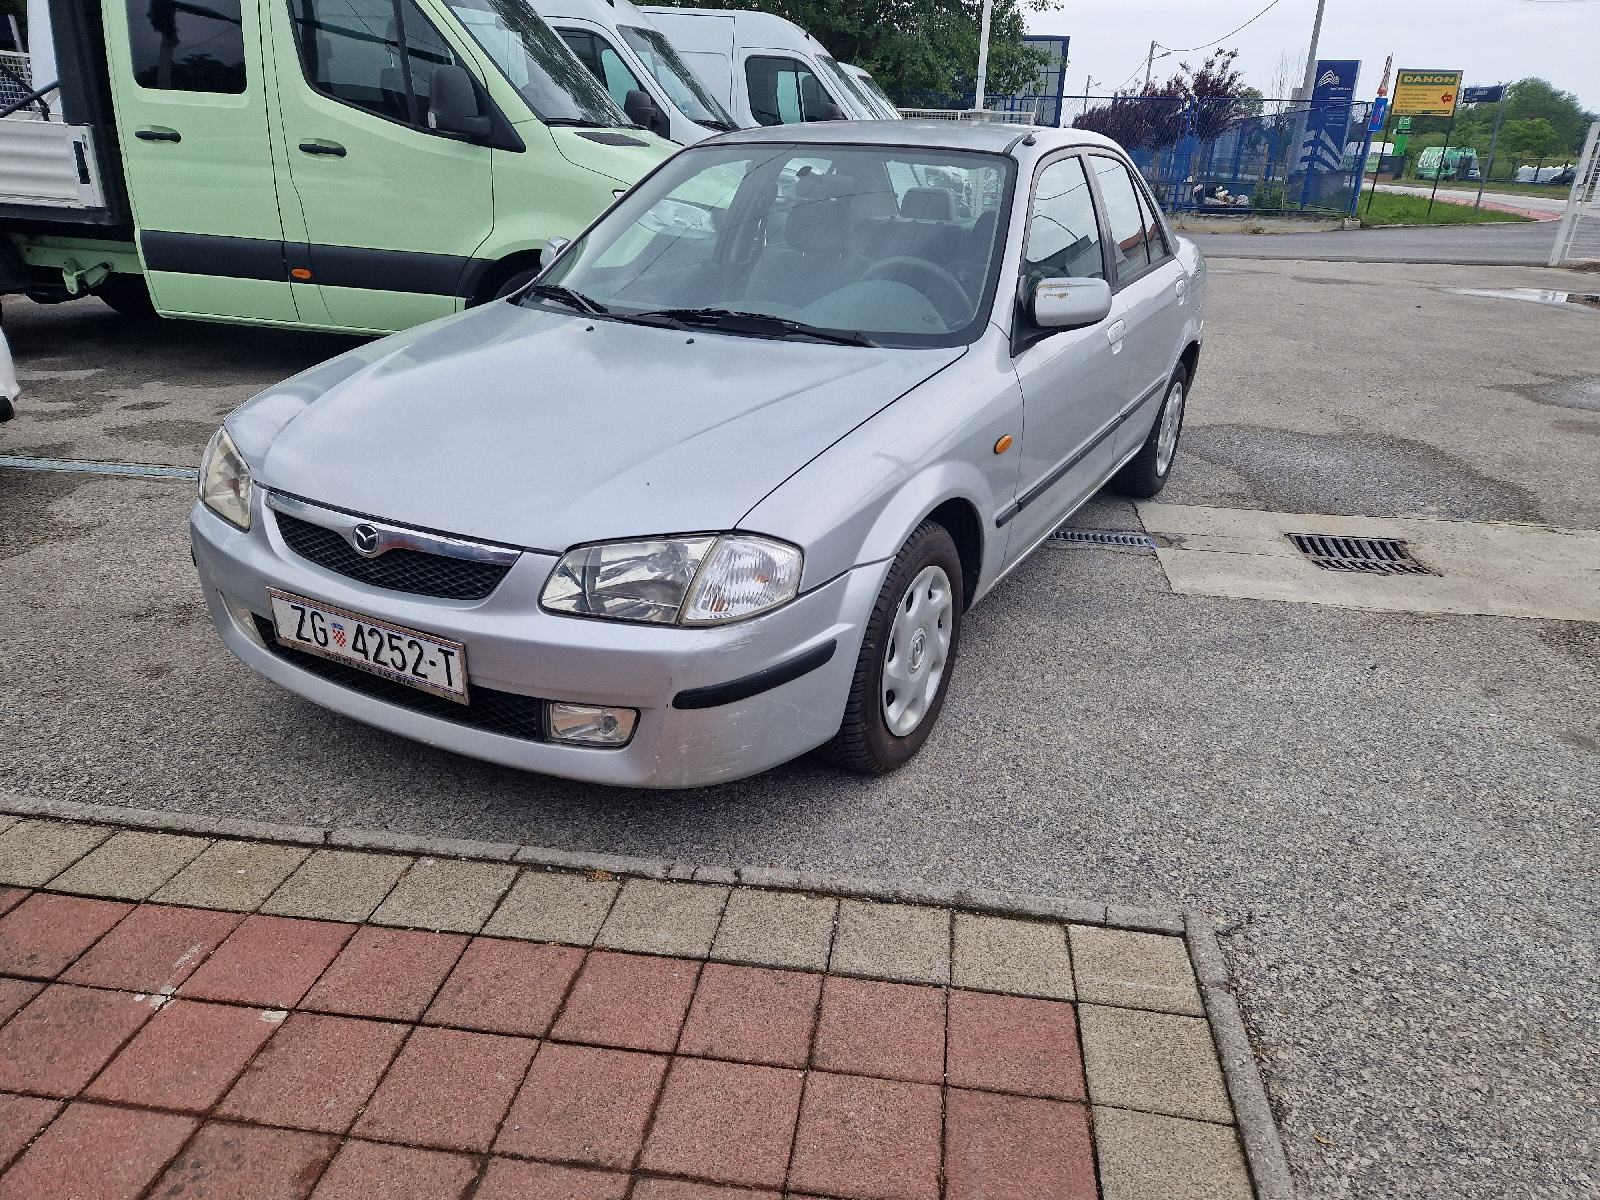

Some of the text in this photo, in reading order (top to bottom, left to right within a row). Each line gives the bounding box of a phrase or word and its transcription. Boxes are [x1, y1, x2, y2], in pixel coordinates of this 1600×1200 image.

[1403, 75, 1455, 83] DANON
[291, 605, 455, 687] ZG 4252-T
